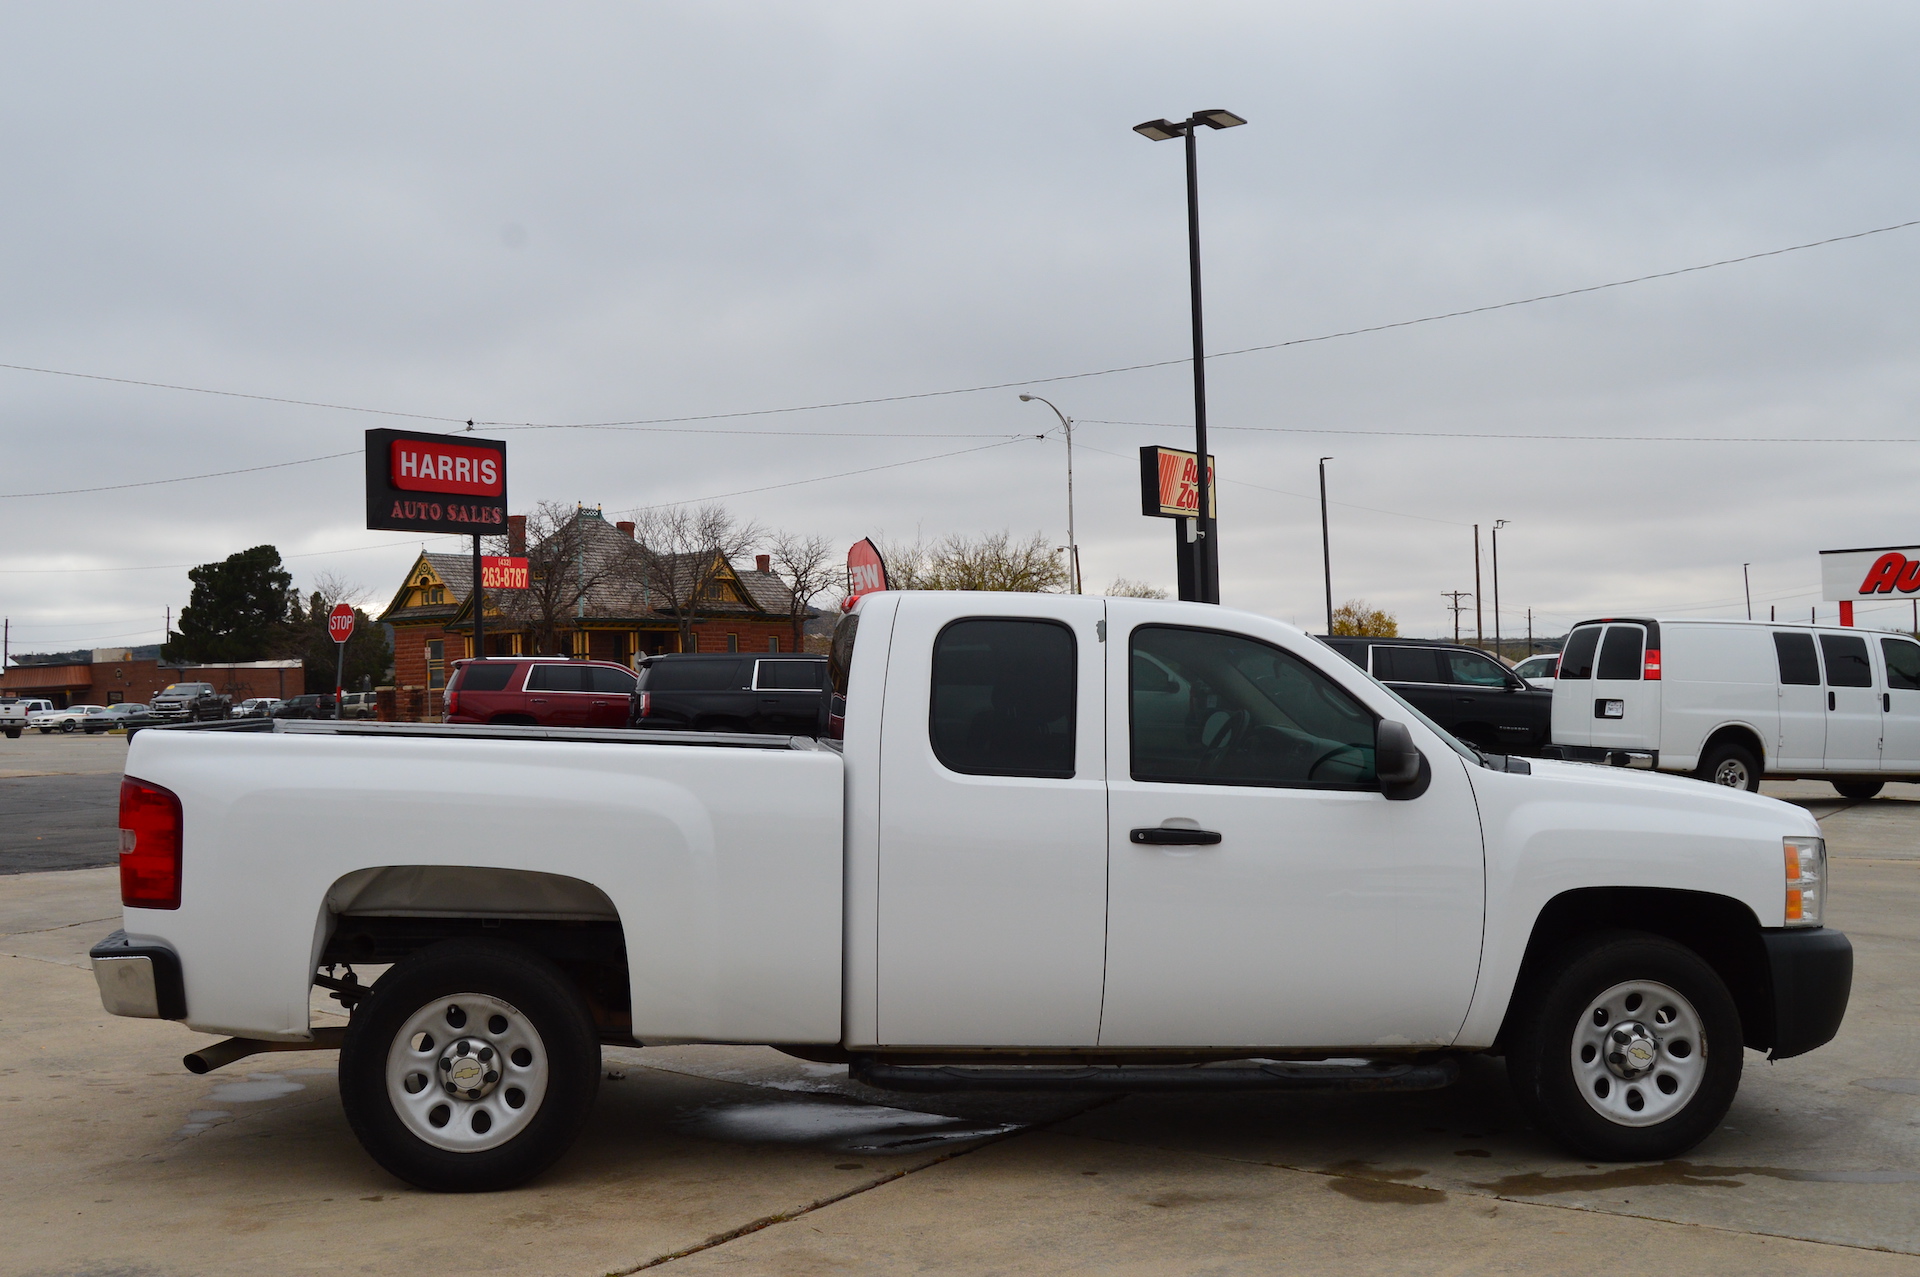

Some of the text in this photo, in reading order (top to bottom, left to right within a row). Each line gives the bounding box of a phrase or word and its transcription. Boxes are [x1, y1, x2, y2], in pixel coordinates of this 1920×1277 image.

[401, 451, 497, 485] HARRIS
[1182, 457, 1213, 484] Auo
[1176, 482, 1200, 509] Zon
[391, 500, 503, 524] AUTO SALES
[482, 566, 527, 588] 263-8787
[330, 615, 353, 630] STOP
